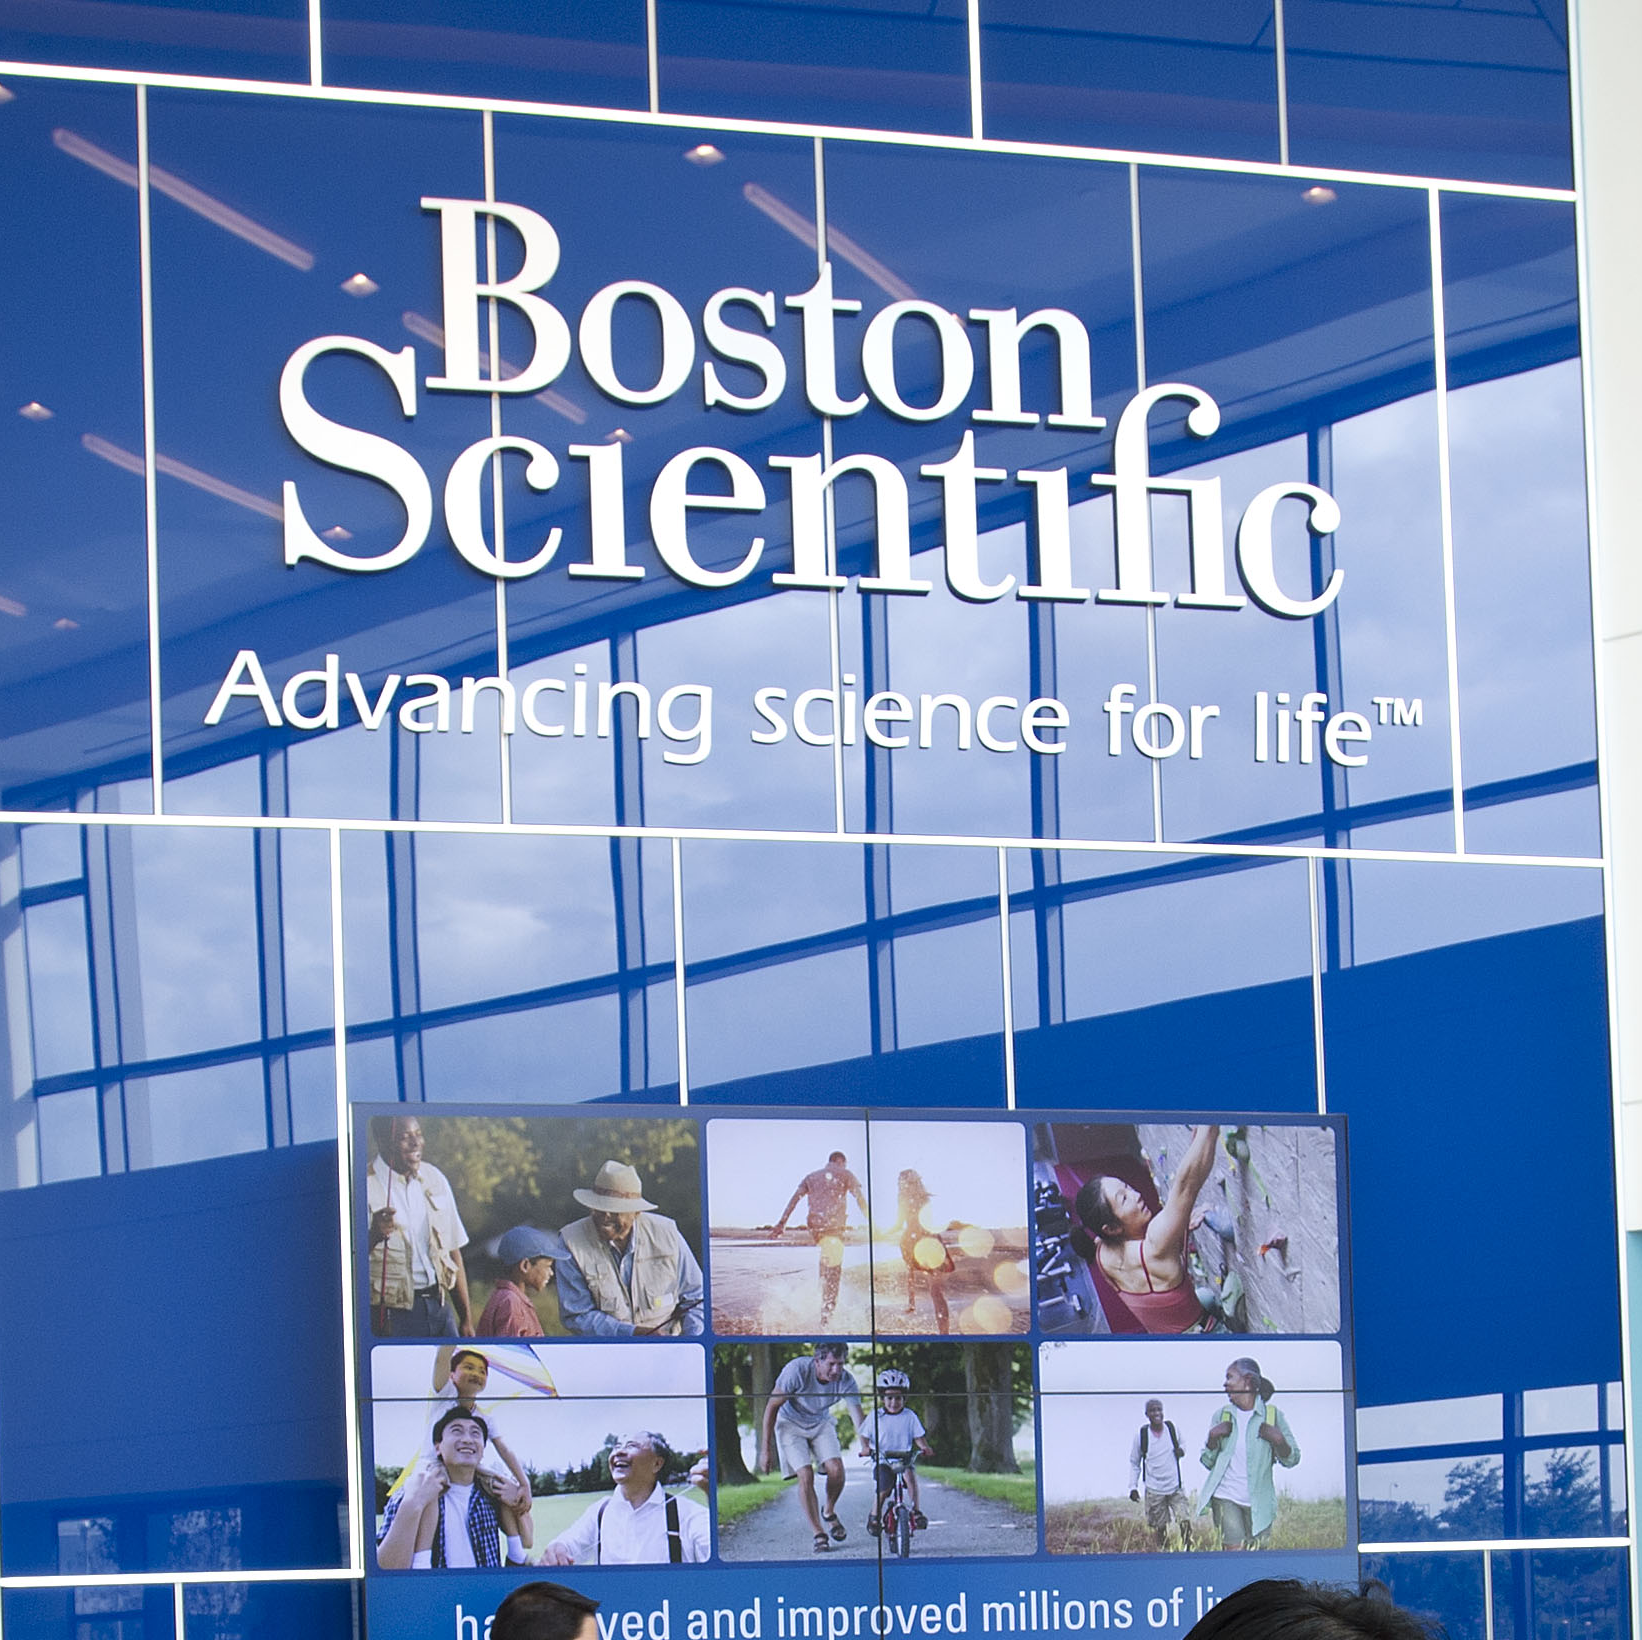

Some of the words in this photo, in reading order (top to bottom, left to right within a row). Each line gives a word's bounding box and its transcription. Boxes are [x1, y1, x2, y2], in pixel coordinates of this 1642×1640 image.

[419, 197, 1107, 430] Boston
[278, 334, 1345, 622] Scientific
[204, 649, 714, 765] Advancing
[750, 673, 1070, 755] science
[1103, 683, 1220, 759] for
[981, 1590, 1134, 1633] millions
[1147, 1586, 1185, 1628] of
